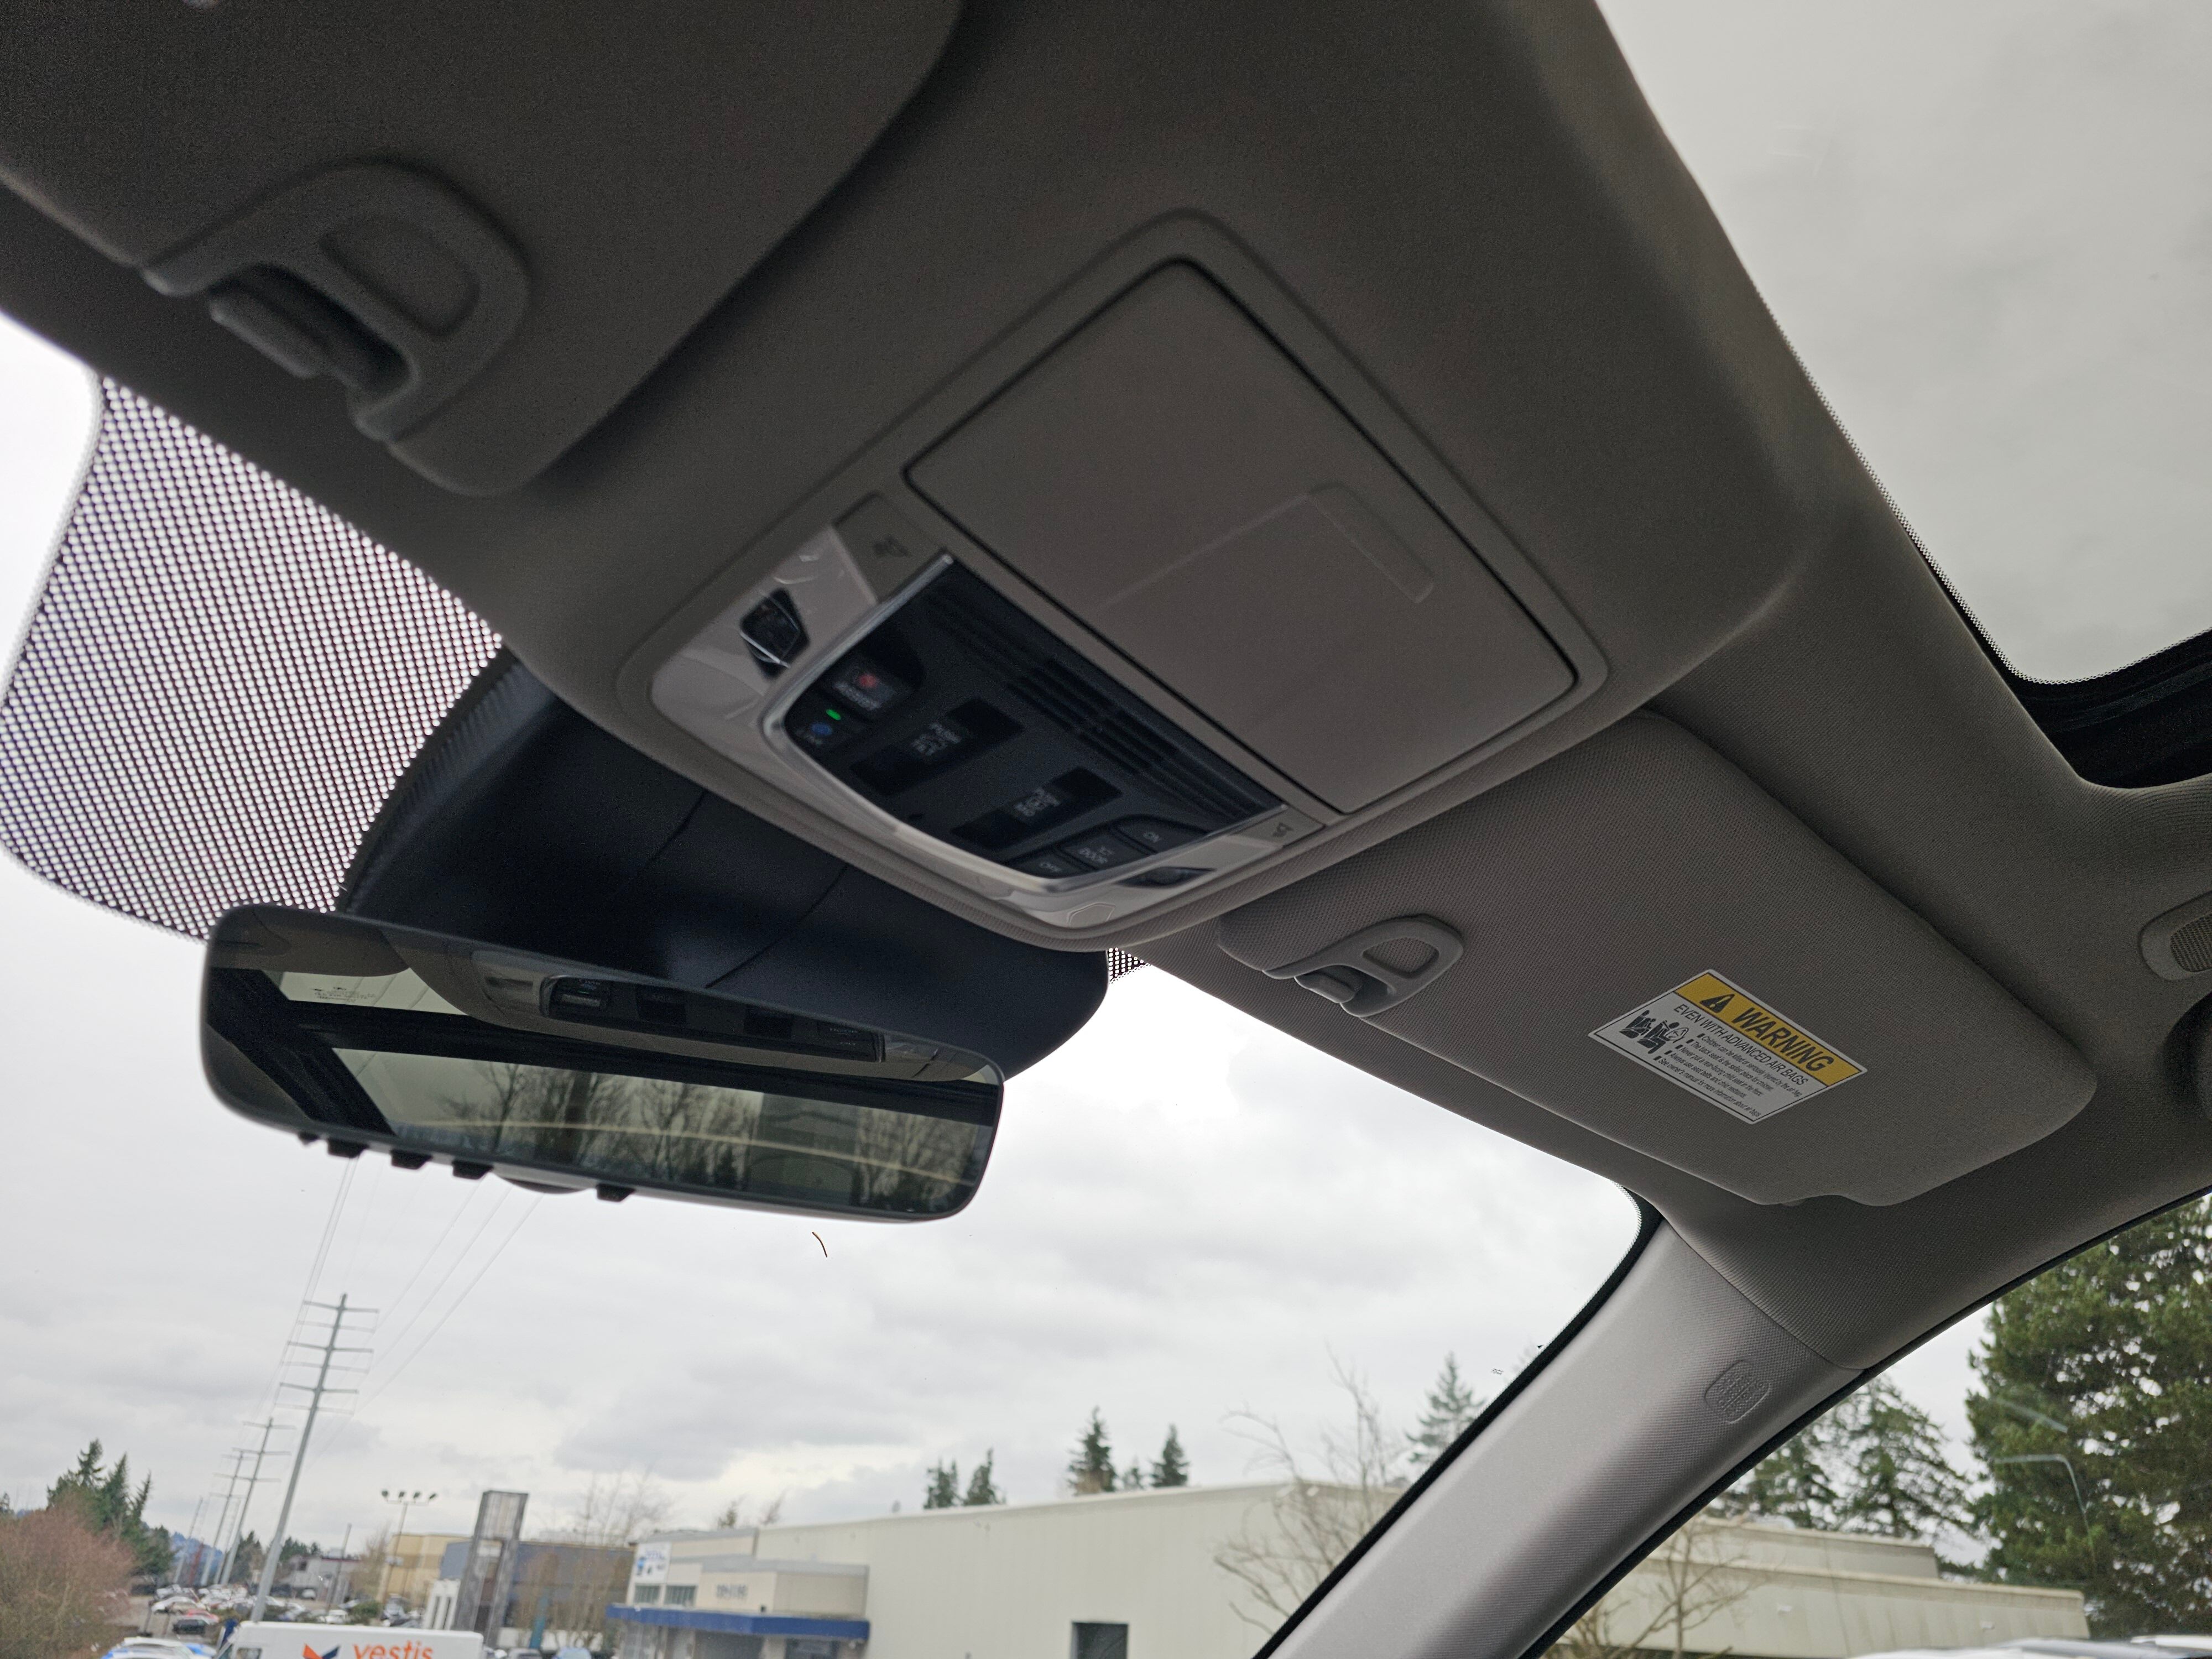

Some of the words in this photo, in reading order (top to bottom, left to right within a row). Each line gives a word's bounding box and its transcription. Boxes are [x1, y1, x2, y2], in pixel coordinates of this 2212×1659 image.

[1674, 1004, 1705, 1023] EVEN
[1699, 1020, 1728, 1037] WITH
[1721, 1034, 1771, 1063] ADVANCED
[1765, 1061, 1786, 1072] AIR
[1780, 1069, 1808, 1085] BAGS
[1700, 1035, 1721, 1048] Children
[1731, 1053, 1746, 1063] killed
[1745, 1063, 1766, 1076] seriously
[1733, 1008, 1833, 1071] WARNING
[1670, 1052, 1687, 1064] Always
[1690, 1066, 1704, 1074] seat
[1699, 1070, 1713, 1079] belts
[1717, 1081, 1731, 1089] child
[1678, 1046, 1695, 1057] Never
[1702, 1060, 1726, 1076] rear-facing
[1722, 1072, 1738, 1081] child
[1731, 1077, 1745, 1086] seat
[1698, 1046, 1712, 1056] back
[1708, 1052, 1722, 1061] seat
[1728, 1064, 1744, 1074] safest
[1666, 1063, 1686, 1075] owner's
[1683, 1072, 1700, 1083] manual
[1703, 1083, 1716, 1092] more
[1733, 1100, 1749, 1109] about
[353, 1641, 434, 1659] vestis
